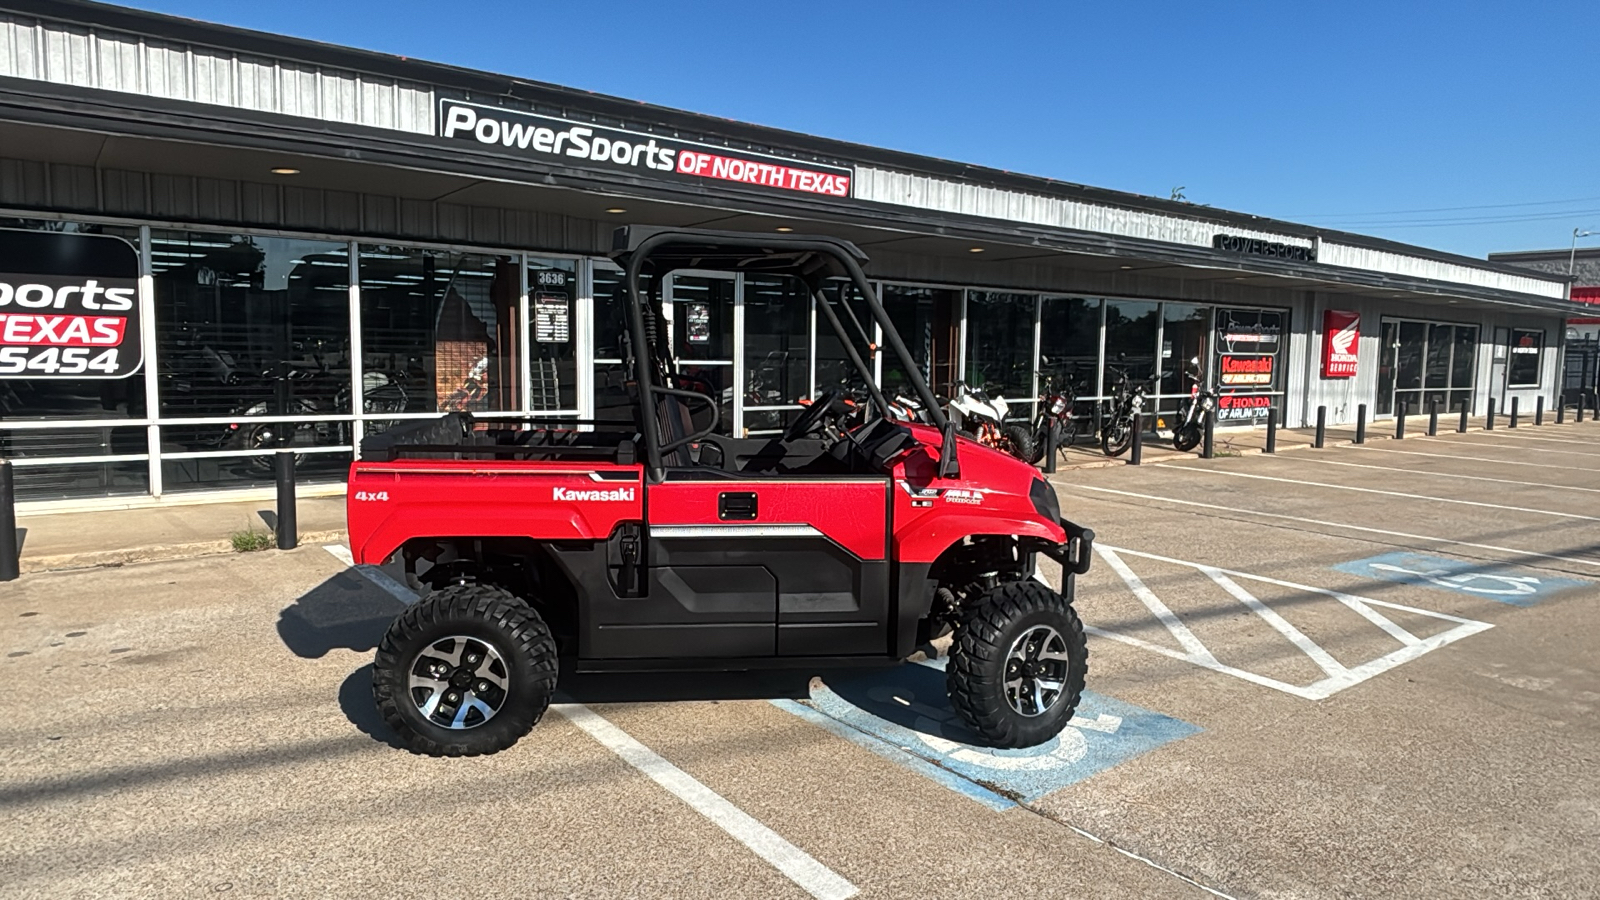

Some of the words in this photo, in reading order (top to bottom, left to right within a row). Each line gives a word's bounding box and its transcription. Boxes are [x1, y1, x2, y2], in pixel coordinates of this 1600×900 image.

[445, 106, 676, 172] PowerSports
[679, 151, 713, 174] OF
[712, 157, 786, 187] NORTH
[786, 169, 847, 197] TEXAS
[538, 272, 564, 285] 3636
[0, 314, 120, 344] EXAS
[1330, 353, 1358, 362] HONDA
[1222, 356, 1273, 373] Kawasaki
[1329, 363, 1358, 373] SERVICE
[1232, 396, 1271, 408] HONDA
[1218, 408, 1230, 419] OF
[1229, 407, 1269, 419] ARLINTON
[355, 491, 390, 501] 4x4
[552, 486, 635, 501] Kawasaki
